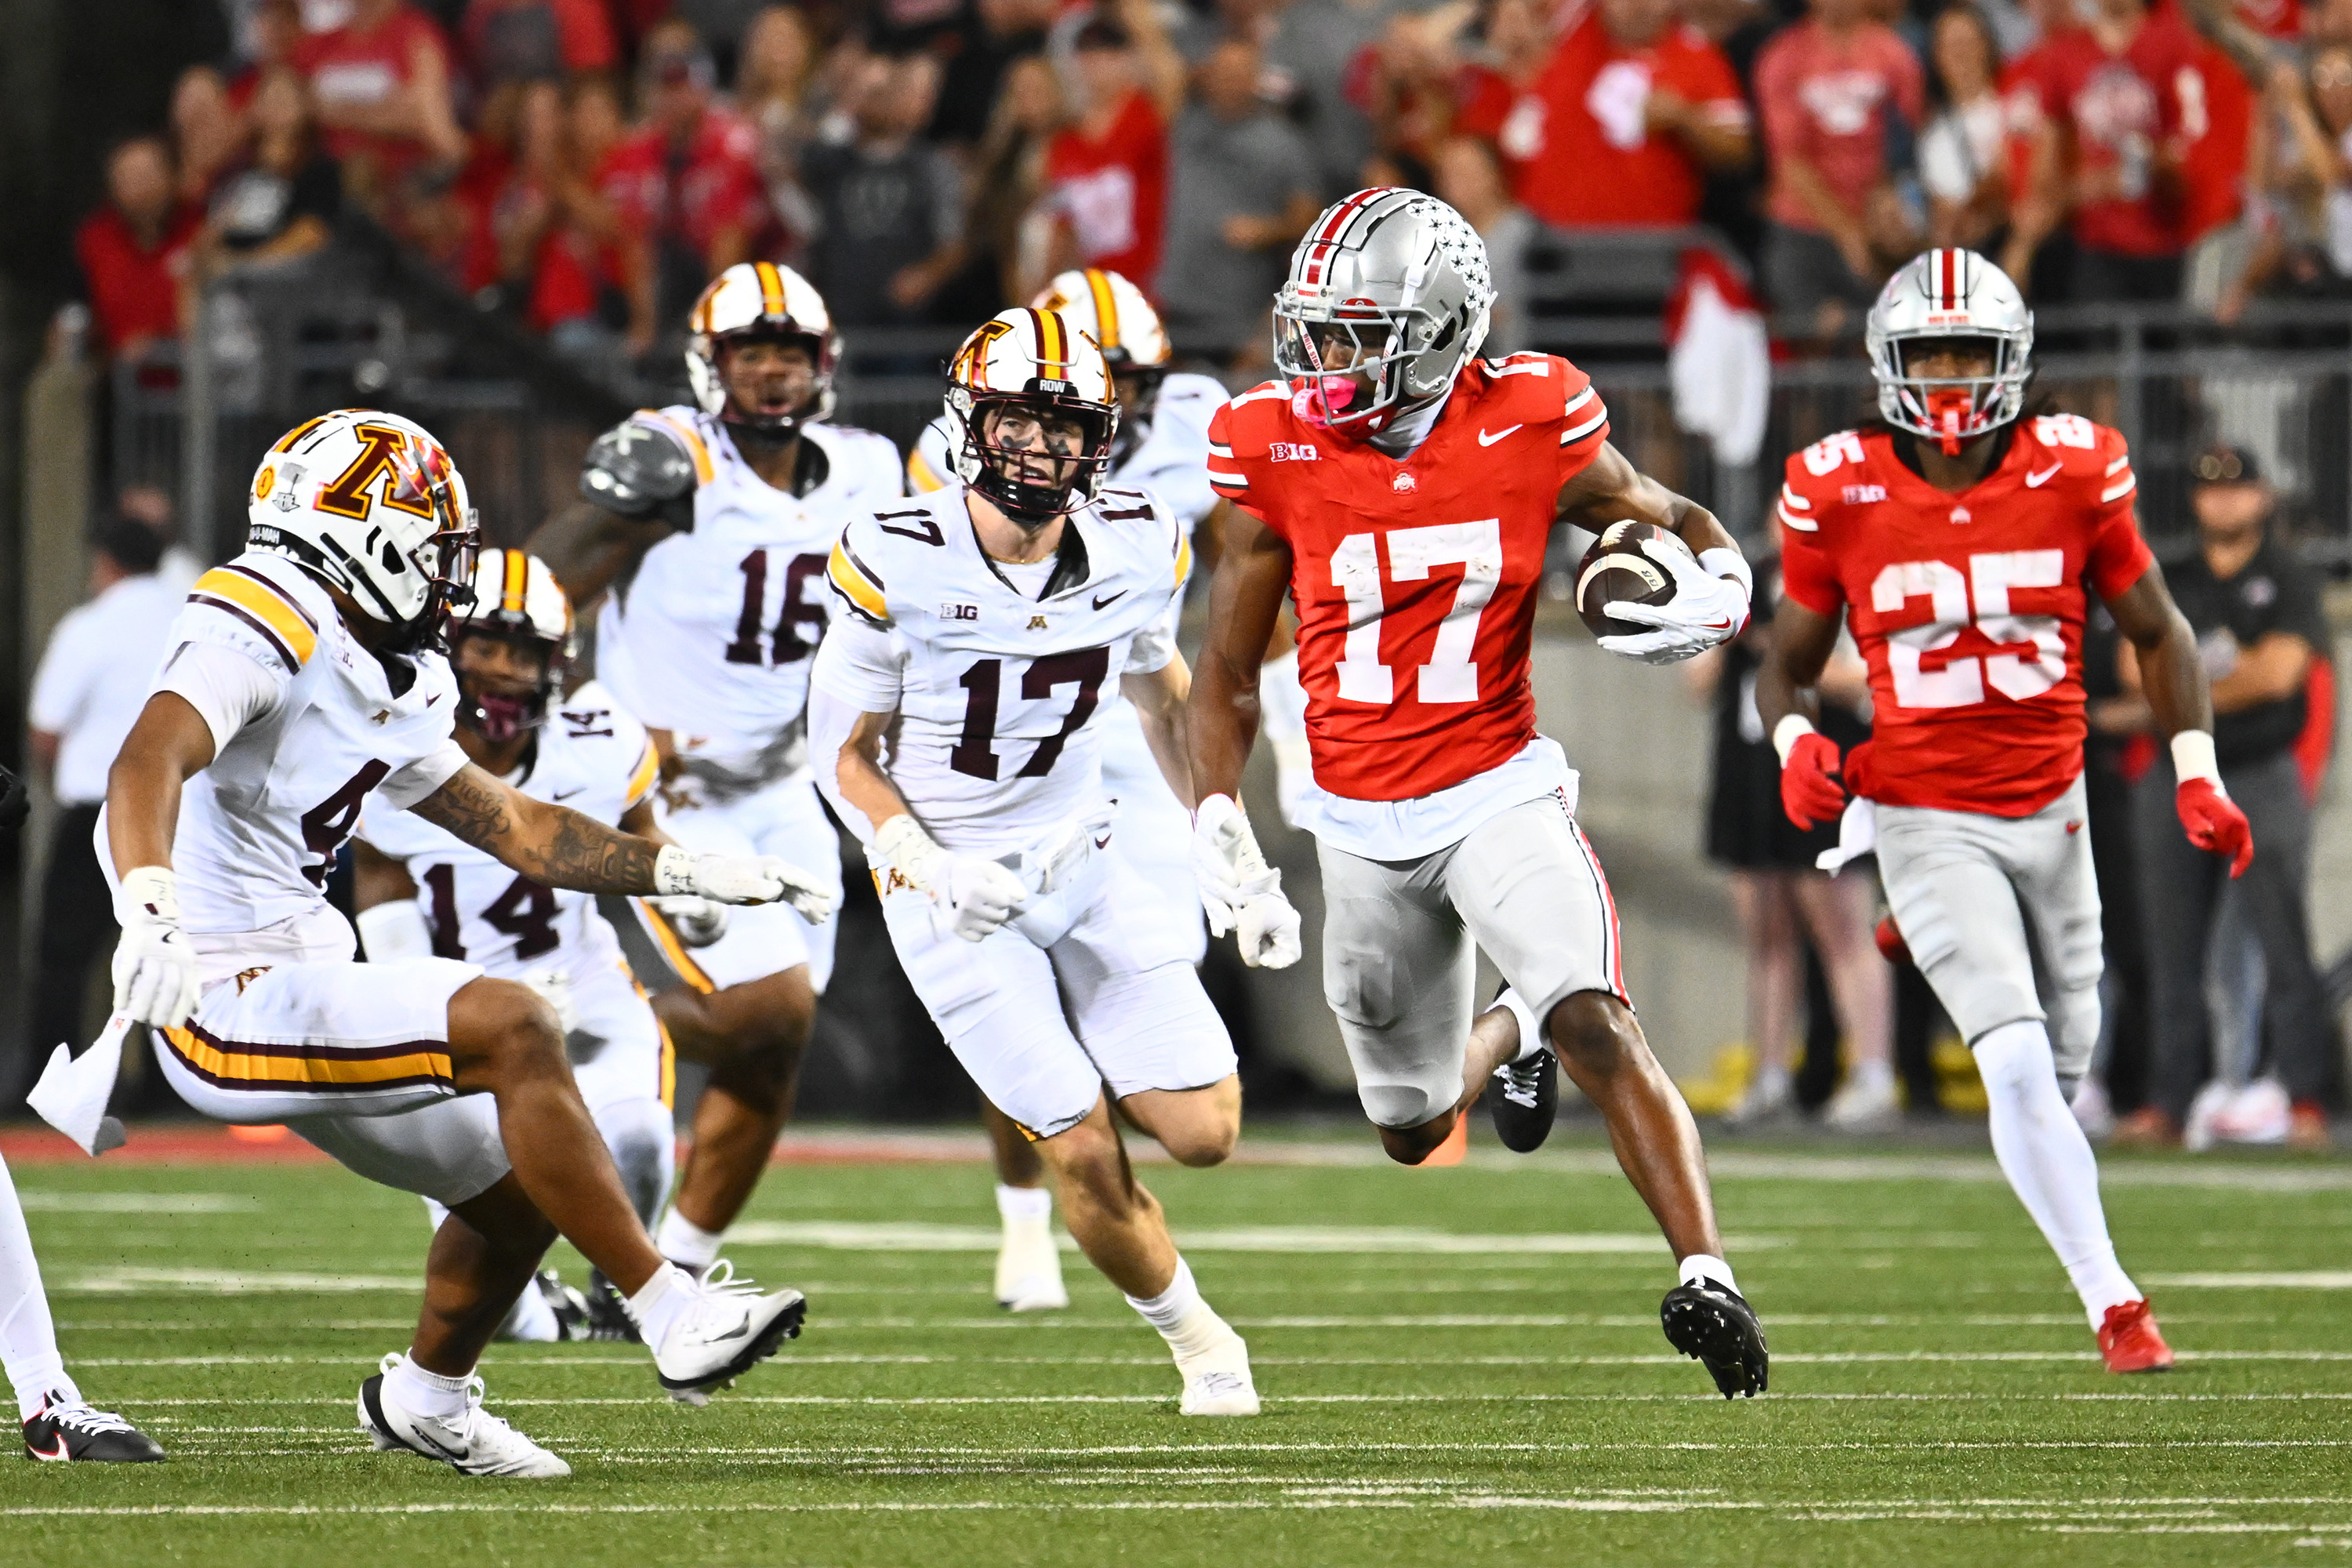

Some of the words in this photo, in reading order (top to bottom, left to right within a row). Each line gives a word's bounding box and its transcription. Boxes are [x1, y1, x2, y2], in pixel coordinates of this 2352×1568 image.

[1039, 379, 1065, 393] ROW
[873, 509, 946, 546] 17
[725, 547, 830, 664] 16
[1330, 518, 1503, 704] 17
[1871, 549, 2067, 708] 25
[561, 710, 613, 737] 14
[950, 646, 1110, 782] 17
[301, 758, 391, 889] 4
[423, 863, 564, 961] 14
